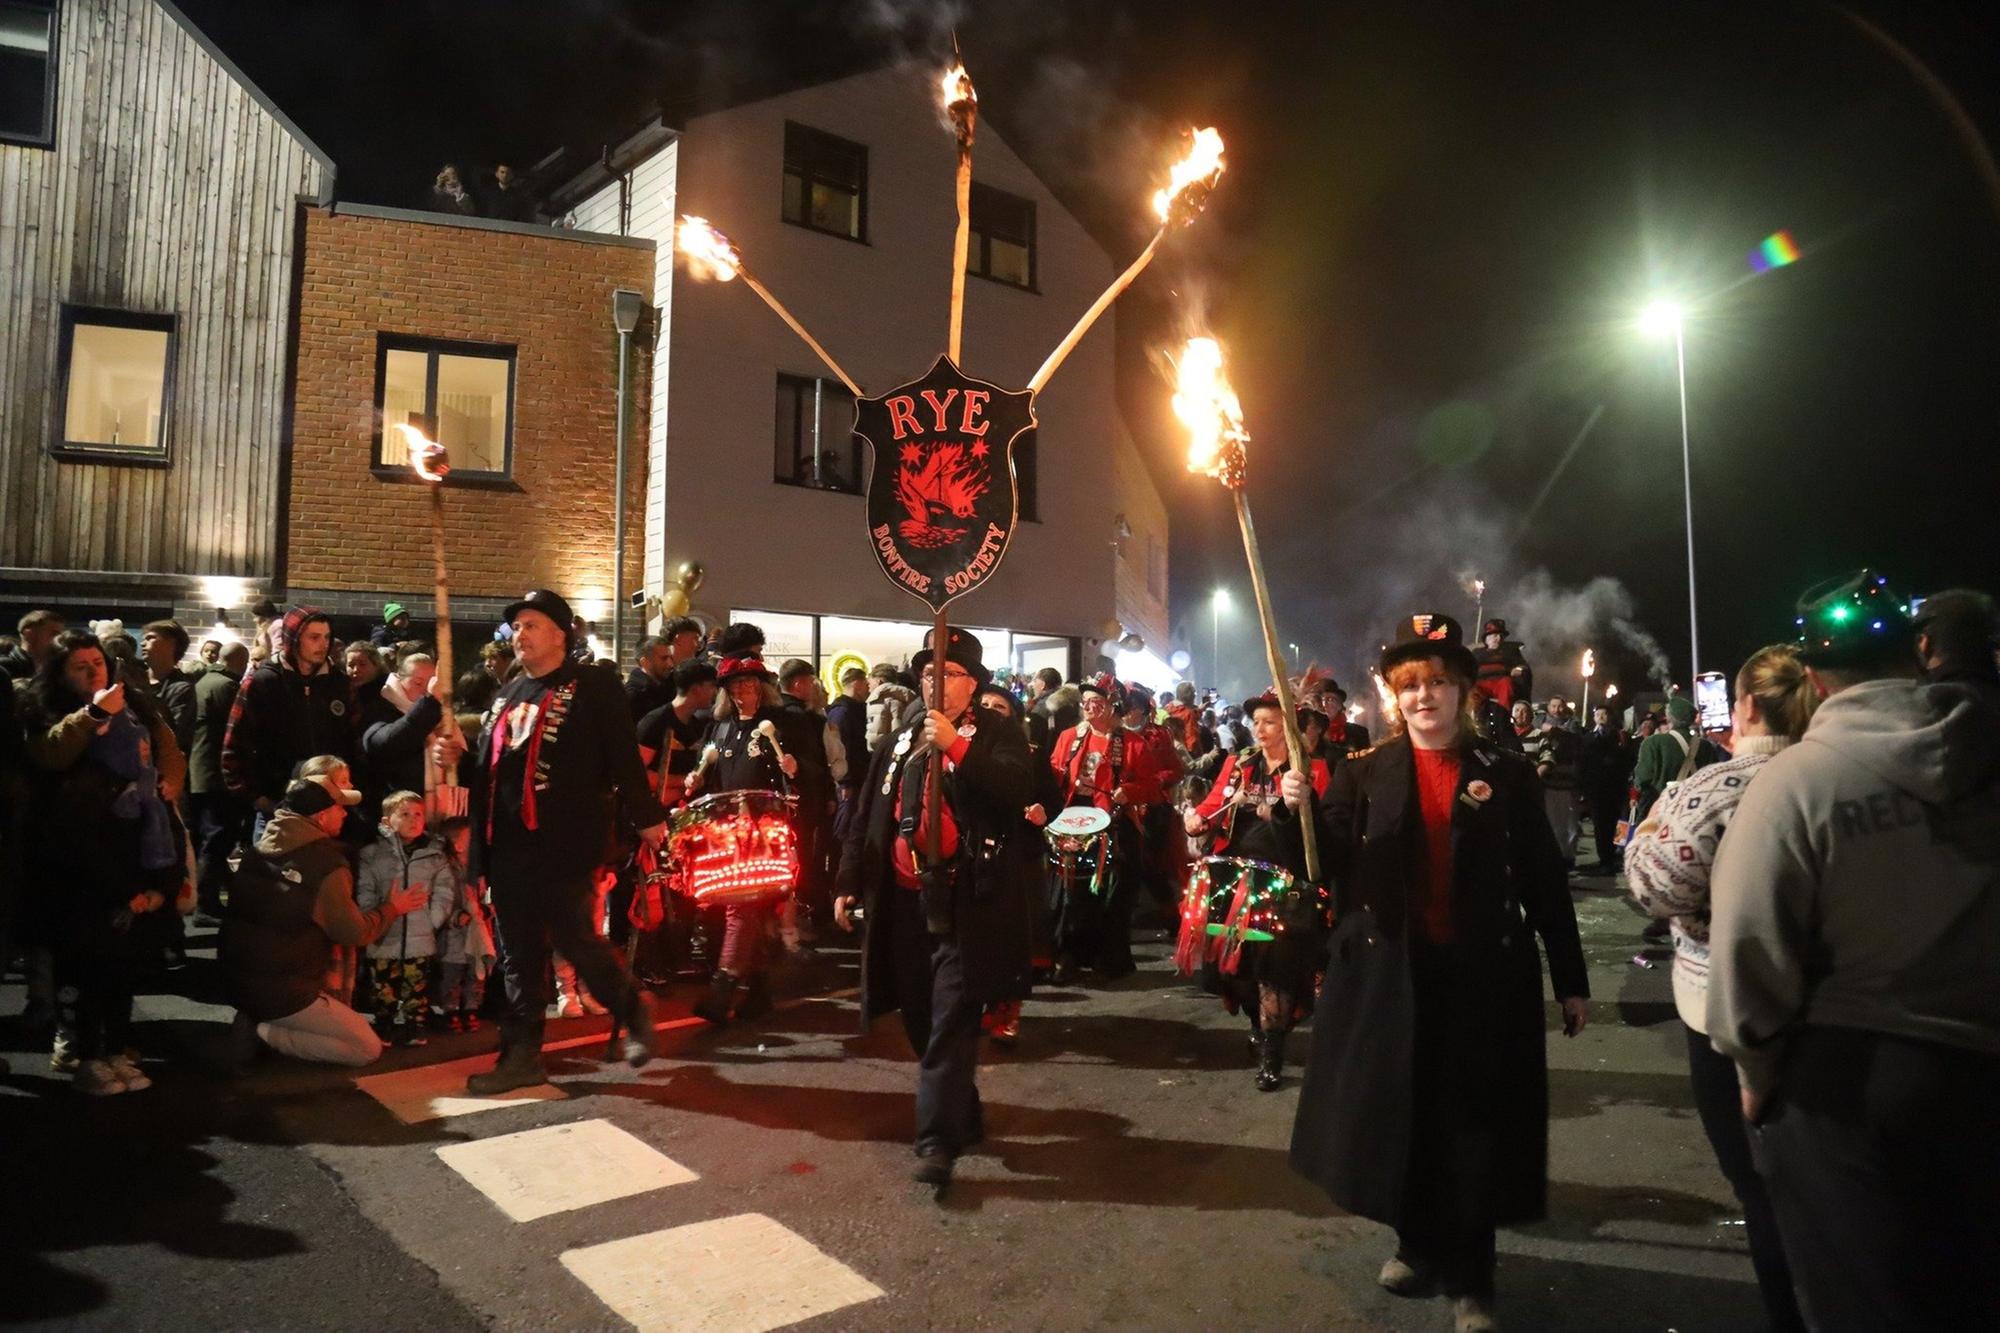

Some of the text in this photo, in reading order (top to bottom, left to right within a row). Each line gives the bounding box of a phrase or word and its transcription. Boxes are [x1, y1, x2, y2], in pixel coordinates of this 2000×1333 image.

[885, 389, 990, 440] RYE
[873, 522, 1005, 594] BONFIRE SOCIETY
